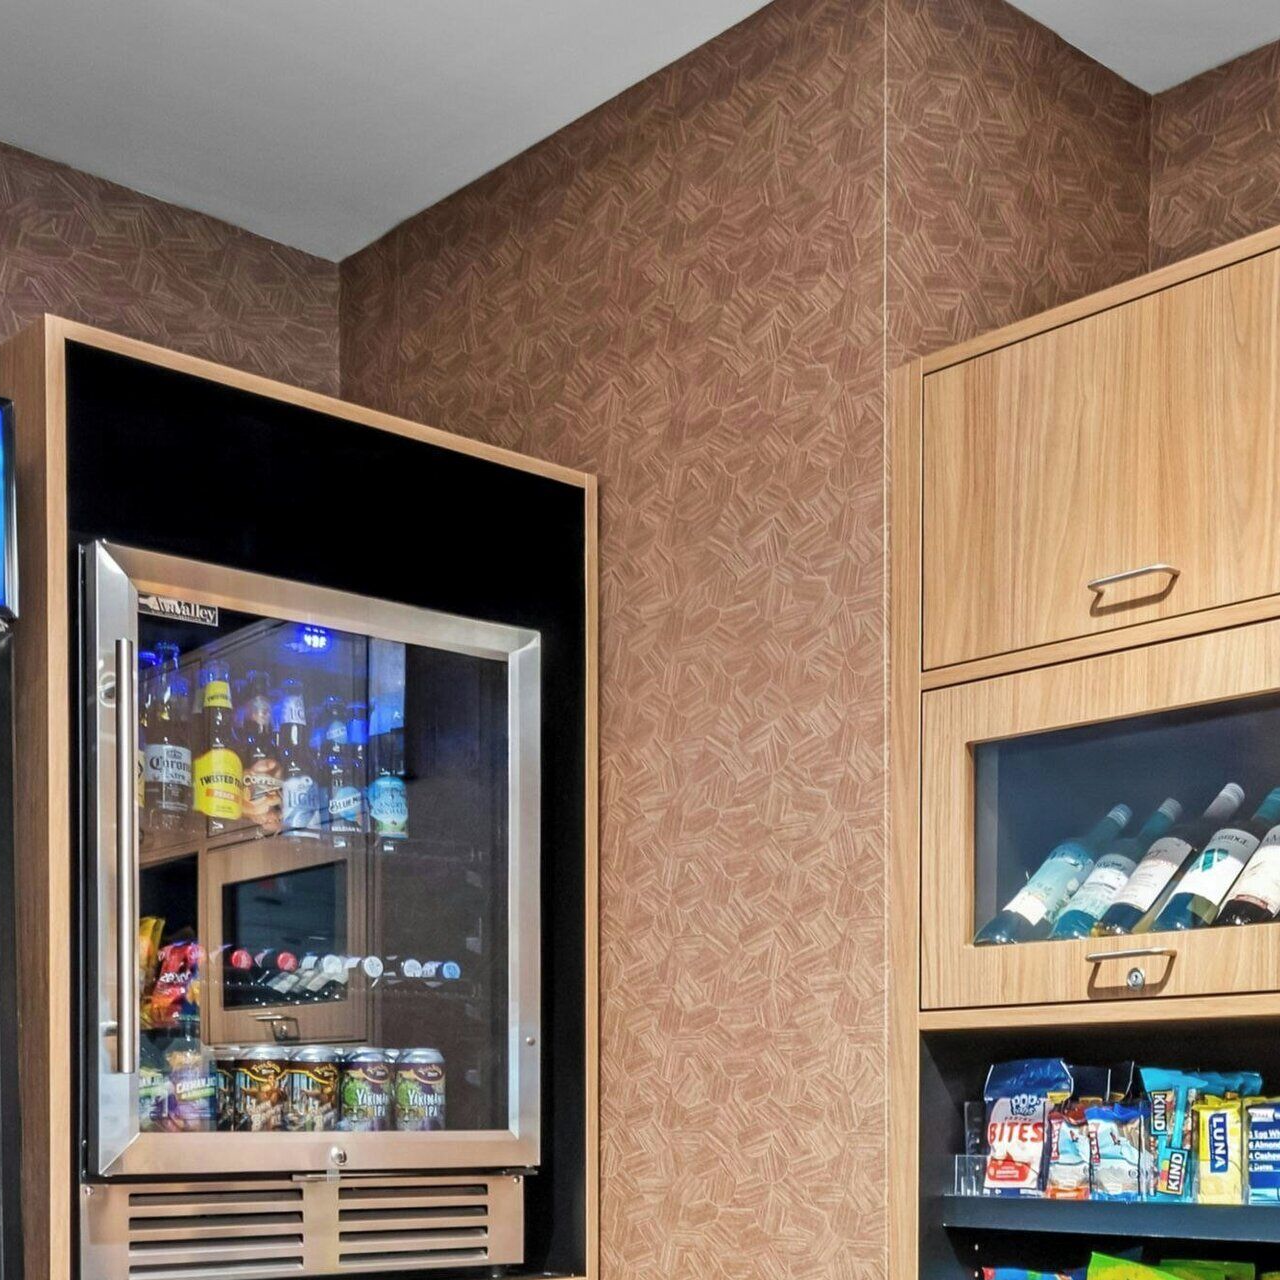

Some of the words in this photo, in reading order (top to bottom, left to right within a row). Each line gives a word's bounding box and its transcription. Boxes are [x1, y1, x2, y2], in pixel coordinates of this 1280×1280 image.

[1154, 1093, 1167, 1131] KIND
[989, 1121, 1045, 1144] BITES
[1212, 1114, 1227, 1169] LUNA
[1254, 1131, 1267, 1140] Egg
[1167, 1153, 1184, 1192] KIND
